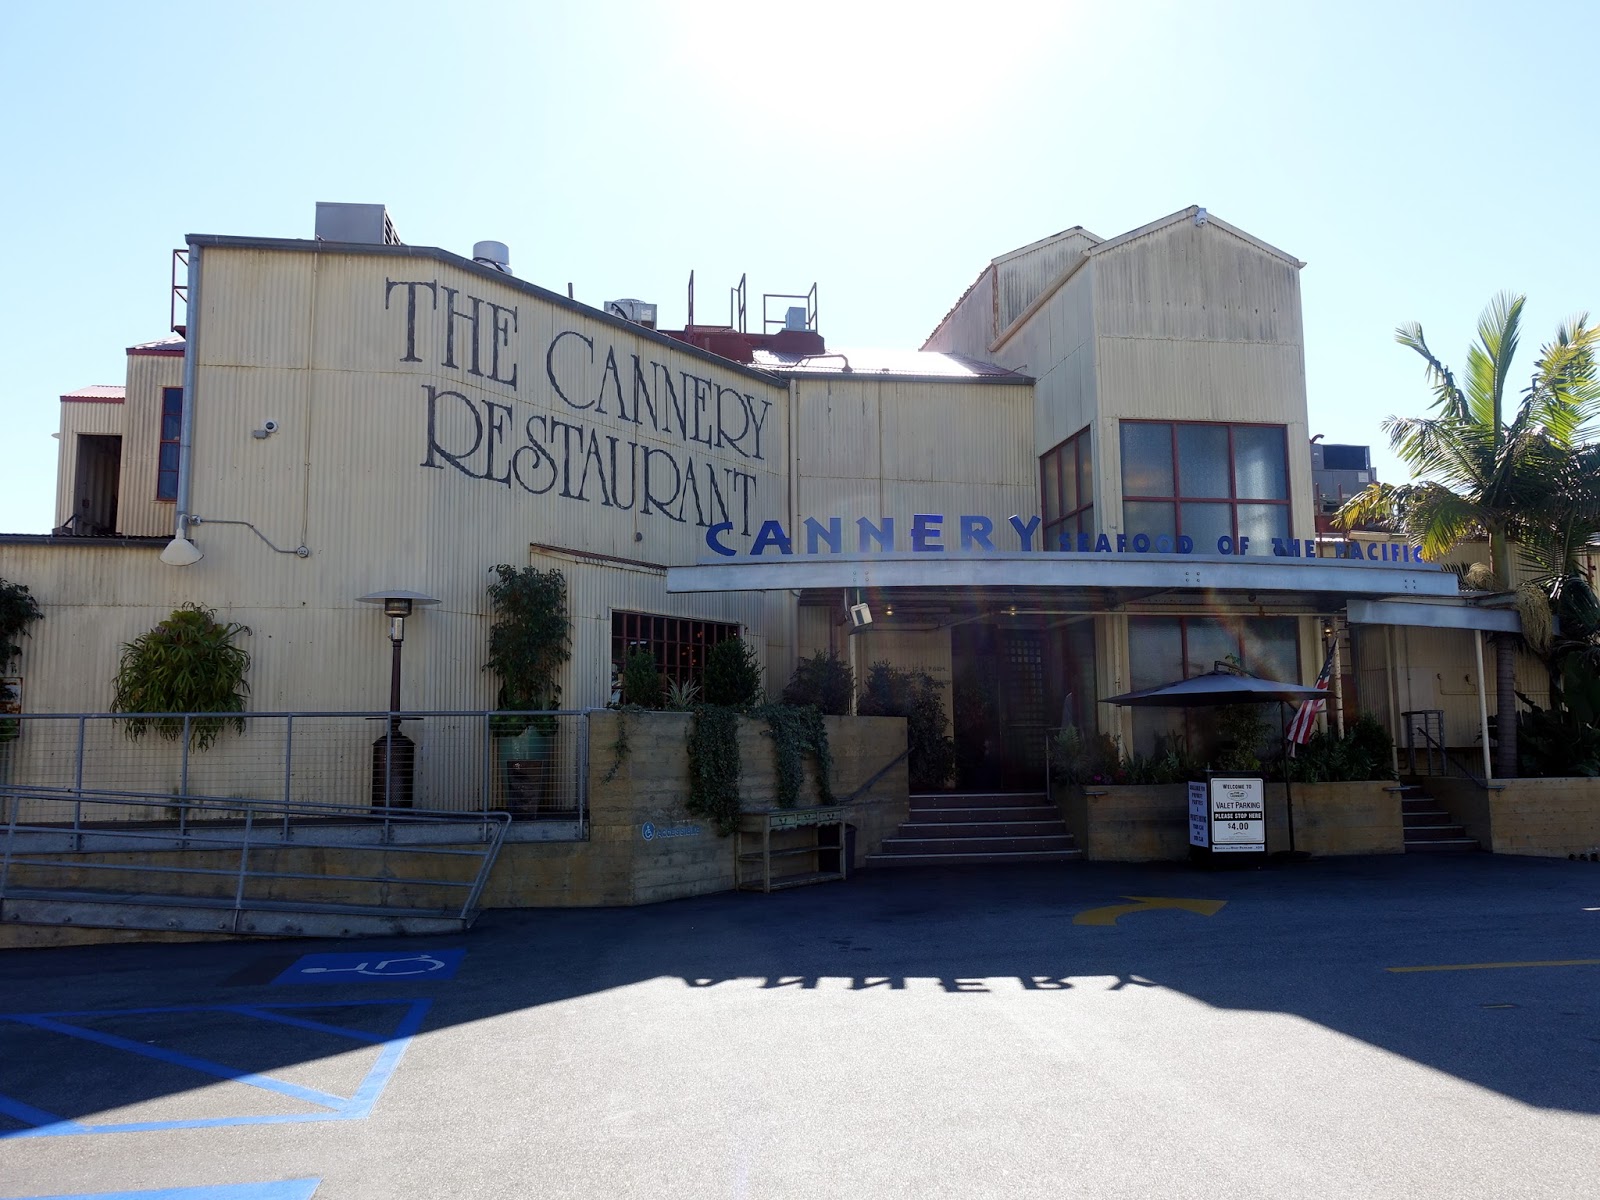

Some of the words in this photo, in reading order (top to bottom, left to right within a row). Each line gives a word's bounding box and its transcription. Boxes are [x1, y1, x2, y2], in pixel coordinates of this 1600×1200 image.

[385, 276, 518, 392] THE
[546, 330, 772, 460] CANNERY
[420, 384, 757, 537] RESTAURANT
[705, 513, 1041, 557] CANNERY
[1059, 532, 1194, 554] SEAFOOD
[1217, 535, 1249, 555] OF
[1271, 537, 1316, 558] THE
[1335, 541, 1424, 563] PACIFIC
[1235, 801, 1261, 809] PARKING
[656, 826, 701, 839] ACCESSIBLE
[1227, 822, 1249, 830] $4.00
